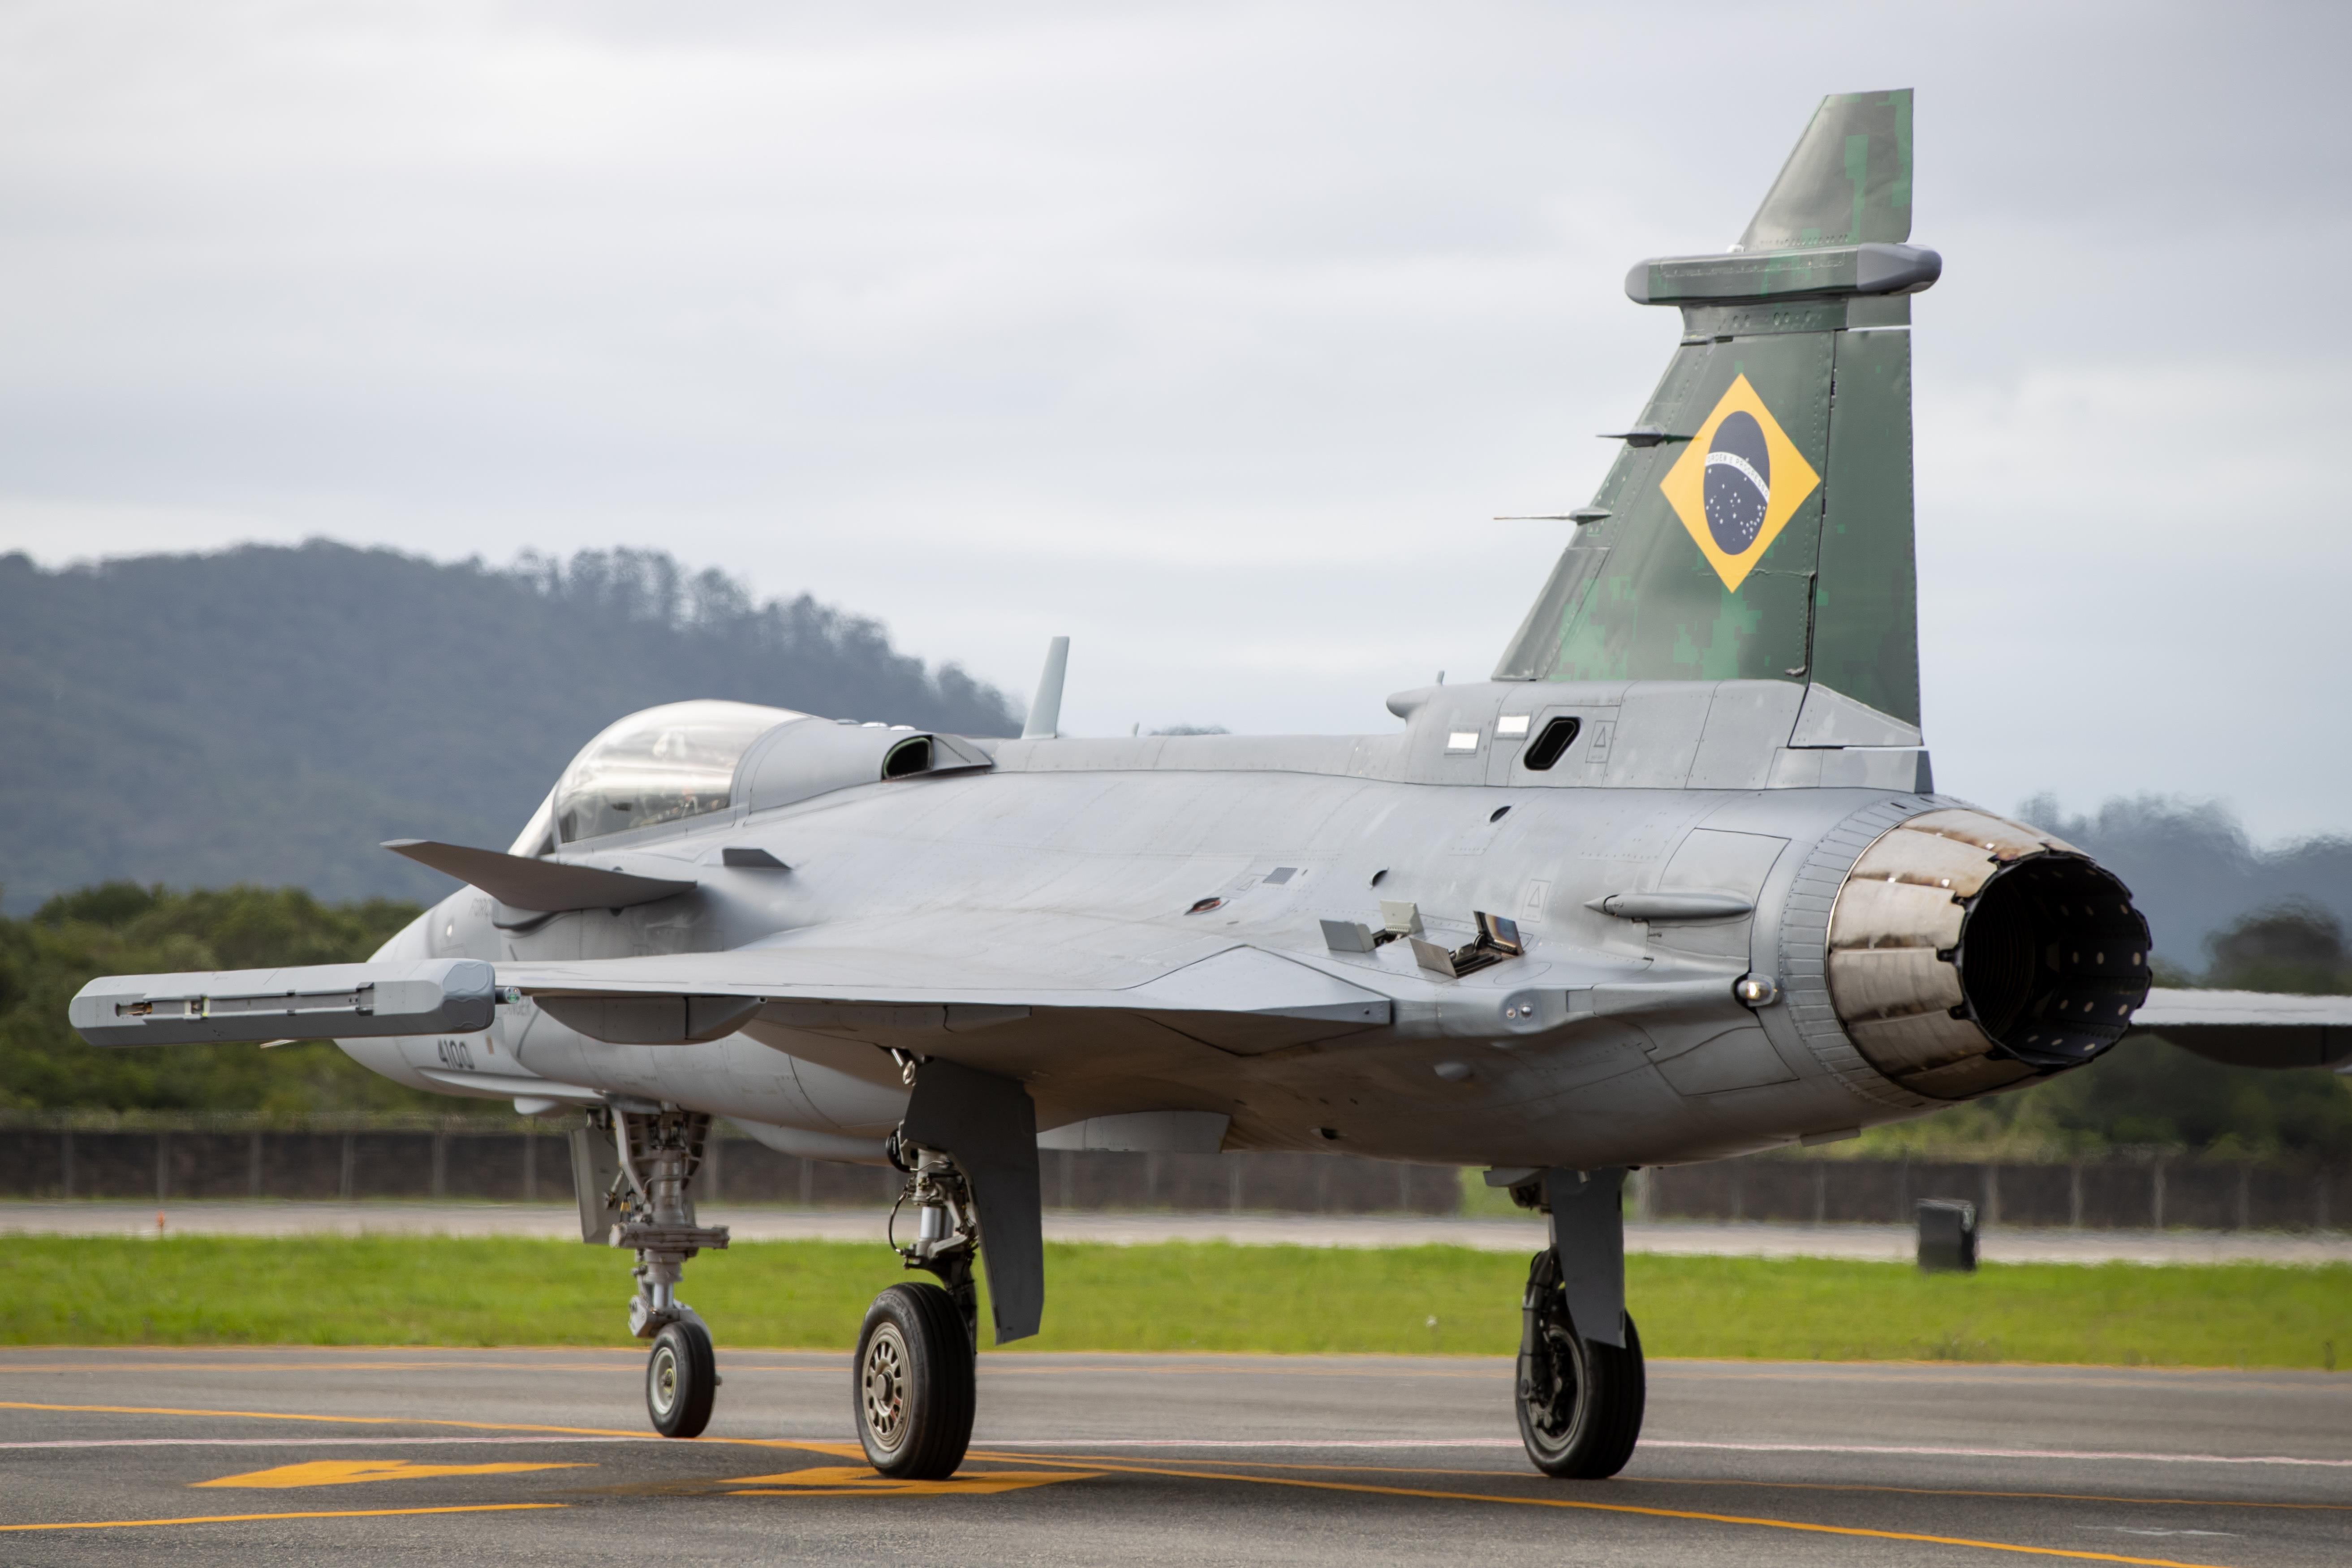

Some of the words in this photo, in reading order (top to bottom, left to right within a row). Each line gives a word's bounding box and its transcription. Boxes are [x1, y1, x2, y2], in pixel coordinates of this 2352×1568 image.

[1706, 453, 1727, 463] ORDEM
[1729, 456, 1733, 464] E
[1736, 458, 1768, 497] PROGRESSO
[437, 1038, 475, 1070] 4100
